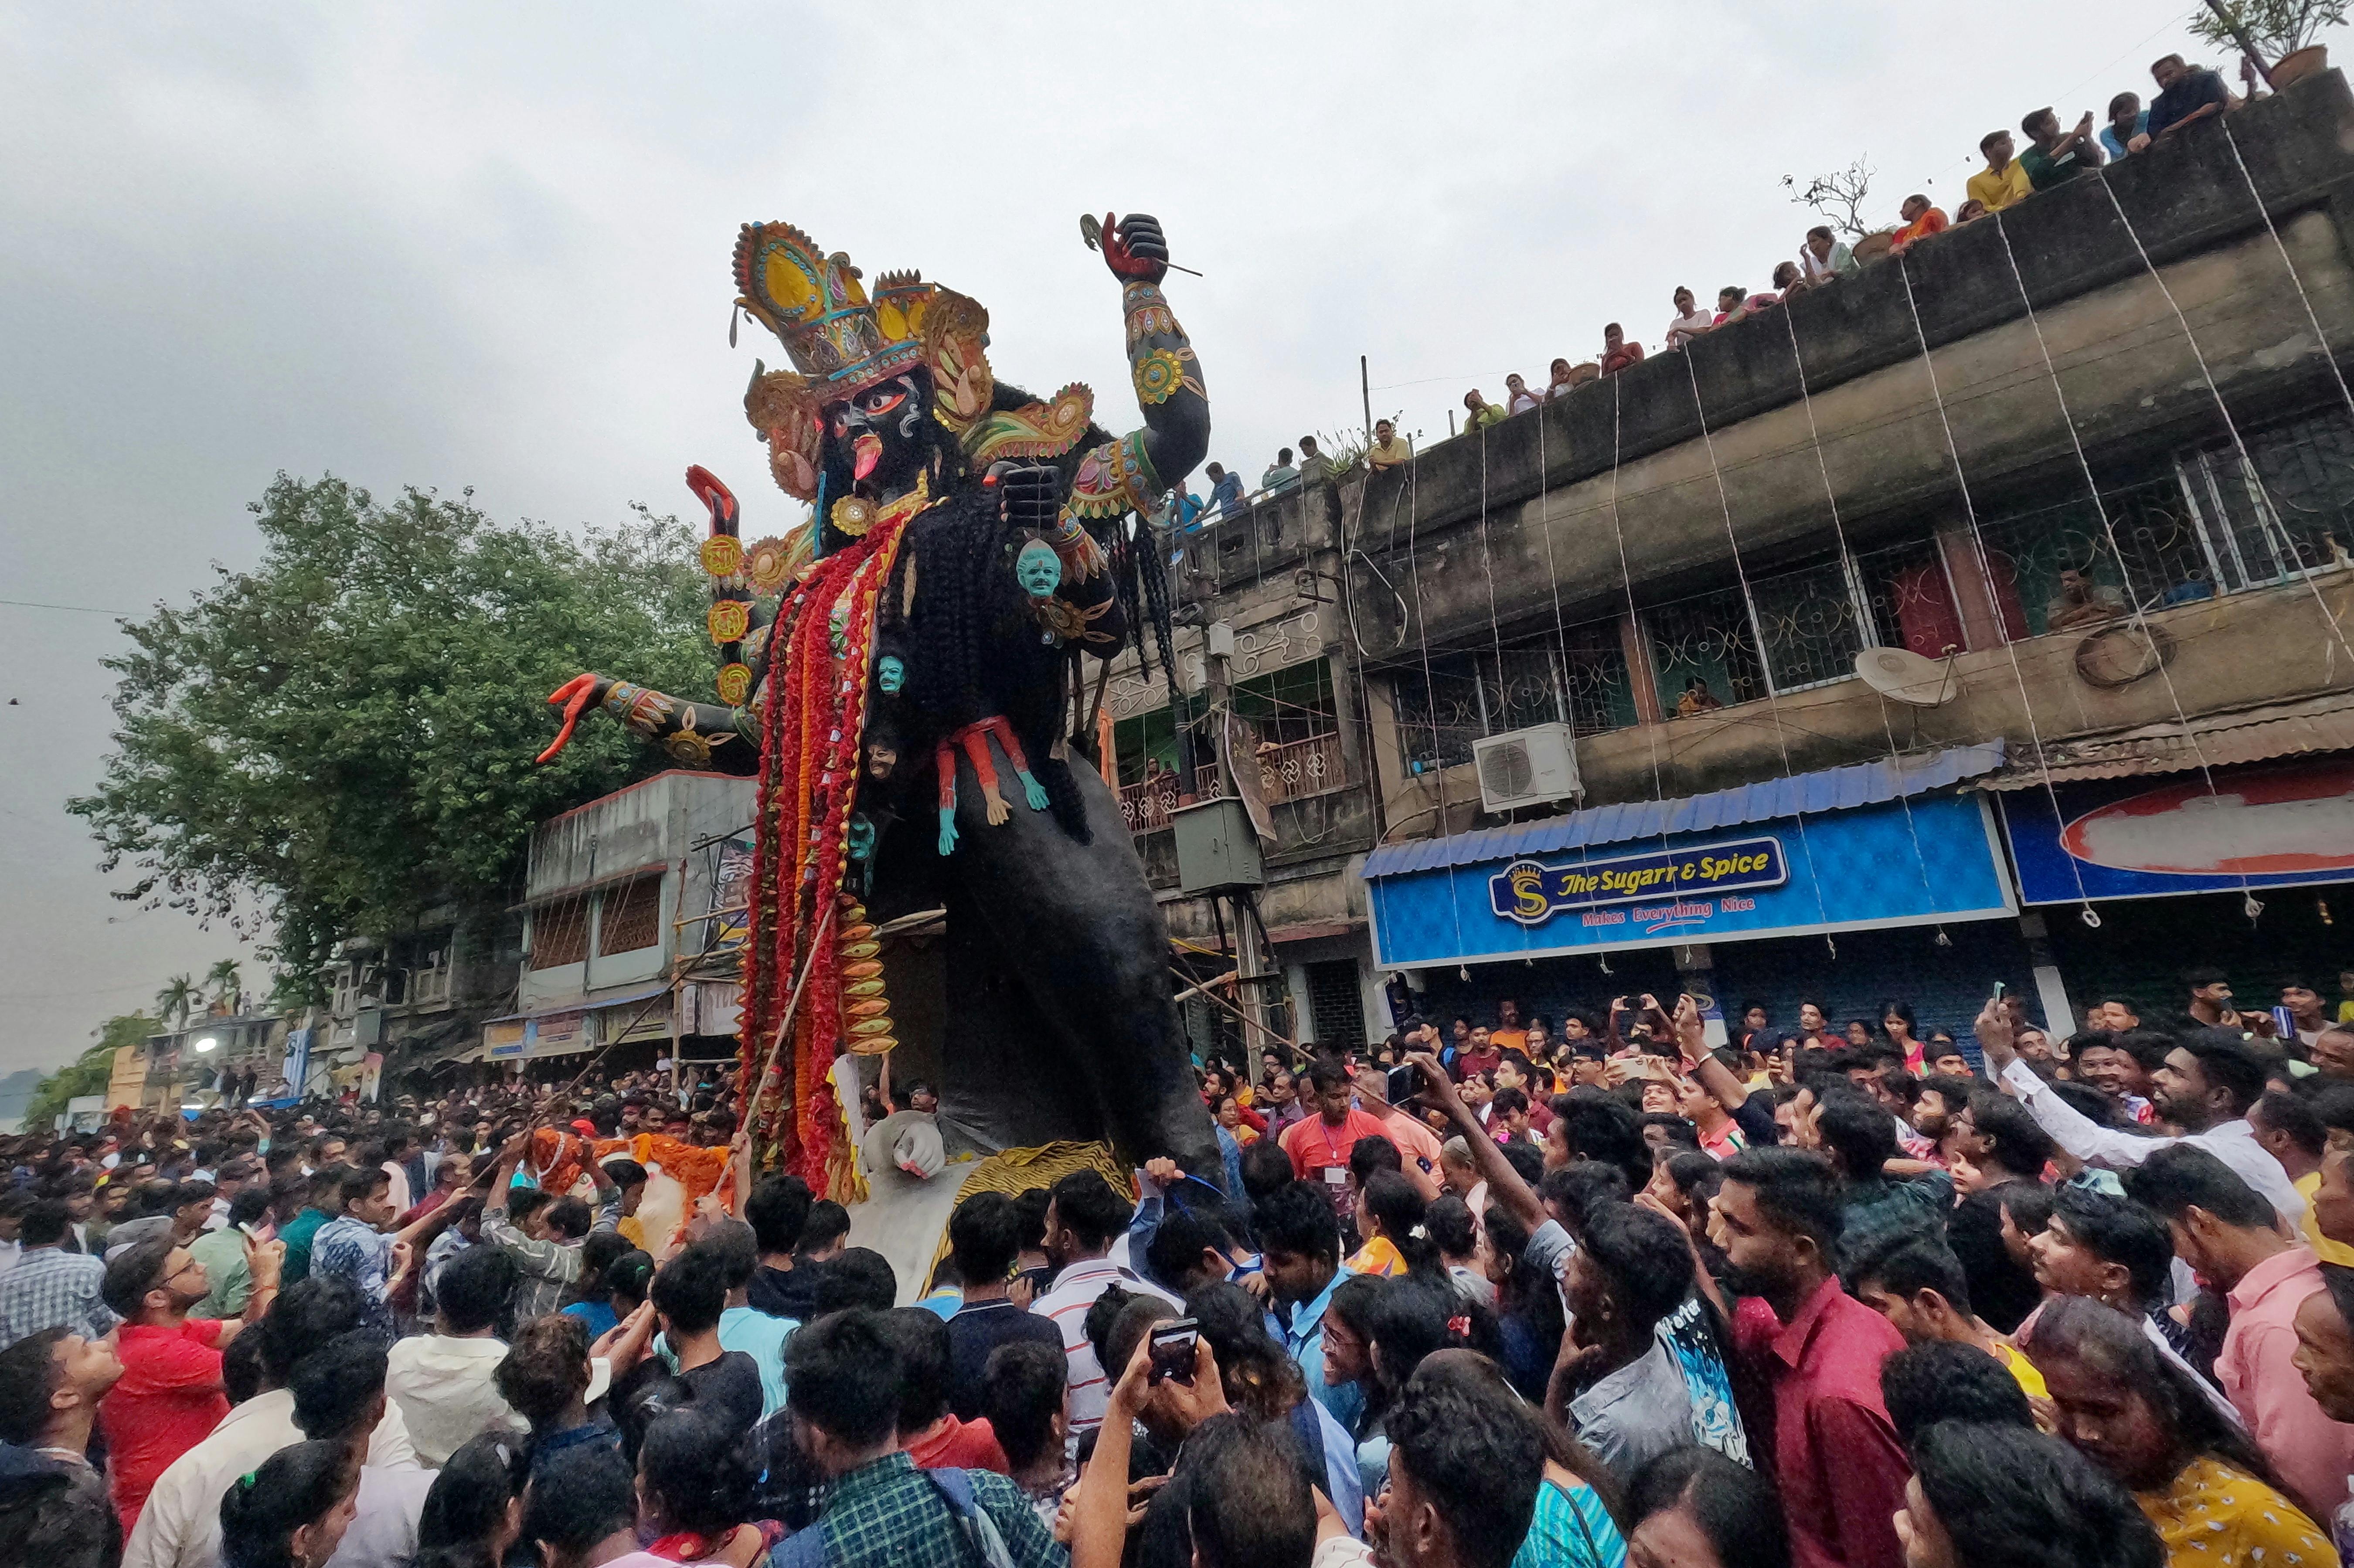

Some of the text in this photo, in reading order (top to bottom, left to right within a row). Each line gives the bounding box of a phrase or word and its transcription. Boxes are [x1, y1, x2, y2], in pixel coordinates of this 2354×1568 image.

[1557, 853, 1769, 896] The Sugarr & Spice
[1582, 896, 1756, 927] Makes Everything Nice
